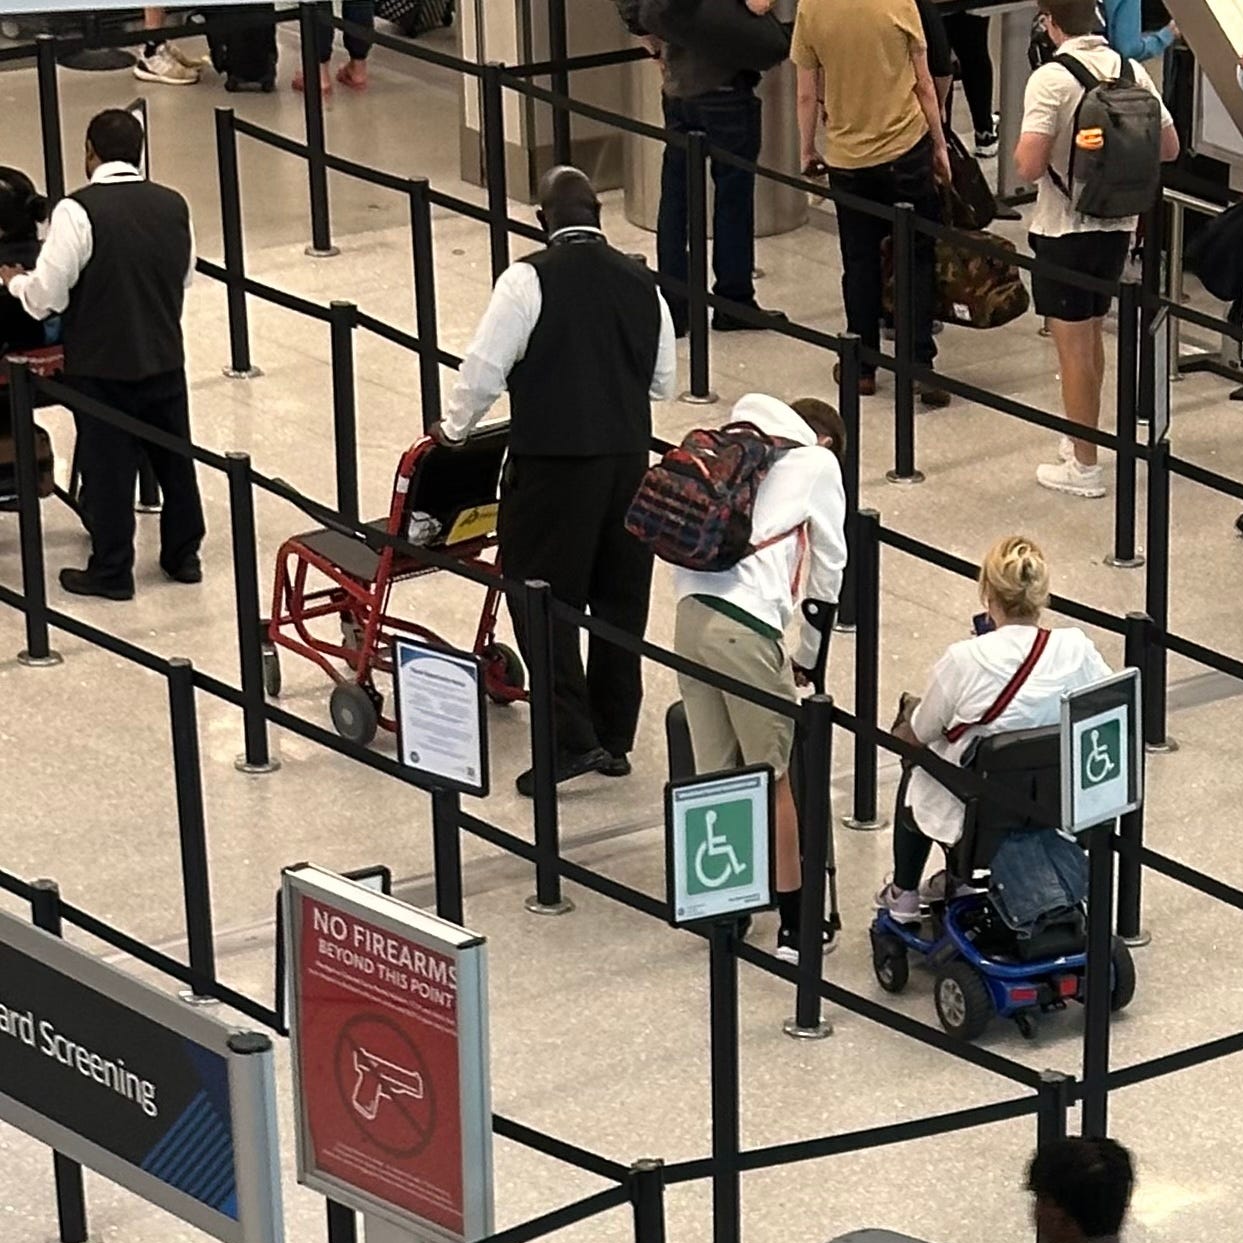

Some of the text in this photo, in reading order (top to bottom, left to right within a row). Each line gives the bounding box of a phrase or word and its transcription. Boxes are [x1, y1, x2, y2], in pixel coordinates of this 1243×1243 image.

[313, 907, 457, 990] NO FIREARMS
[318, 939, 454, 1007] BEYOND THIS POINT
[0, 1003, 158, 1117] ard Screening
